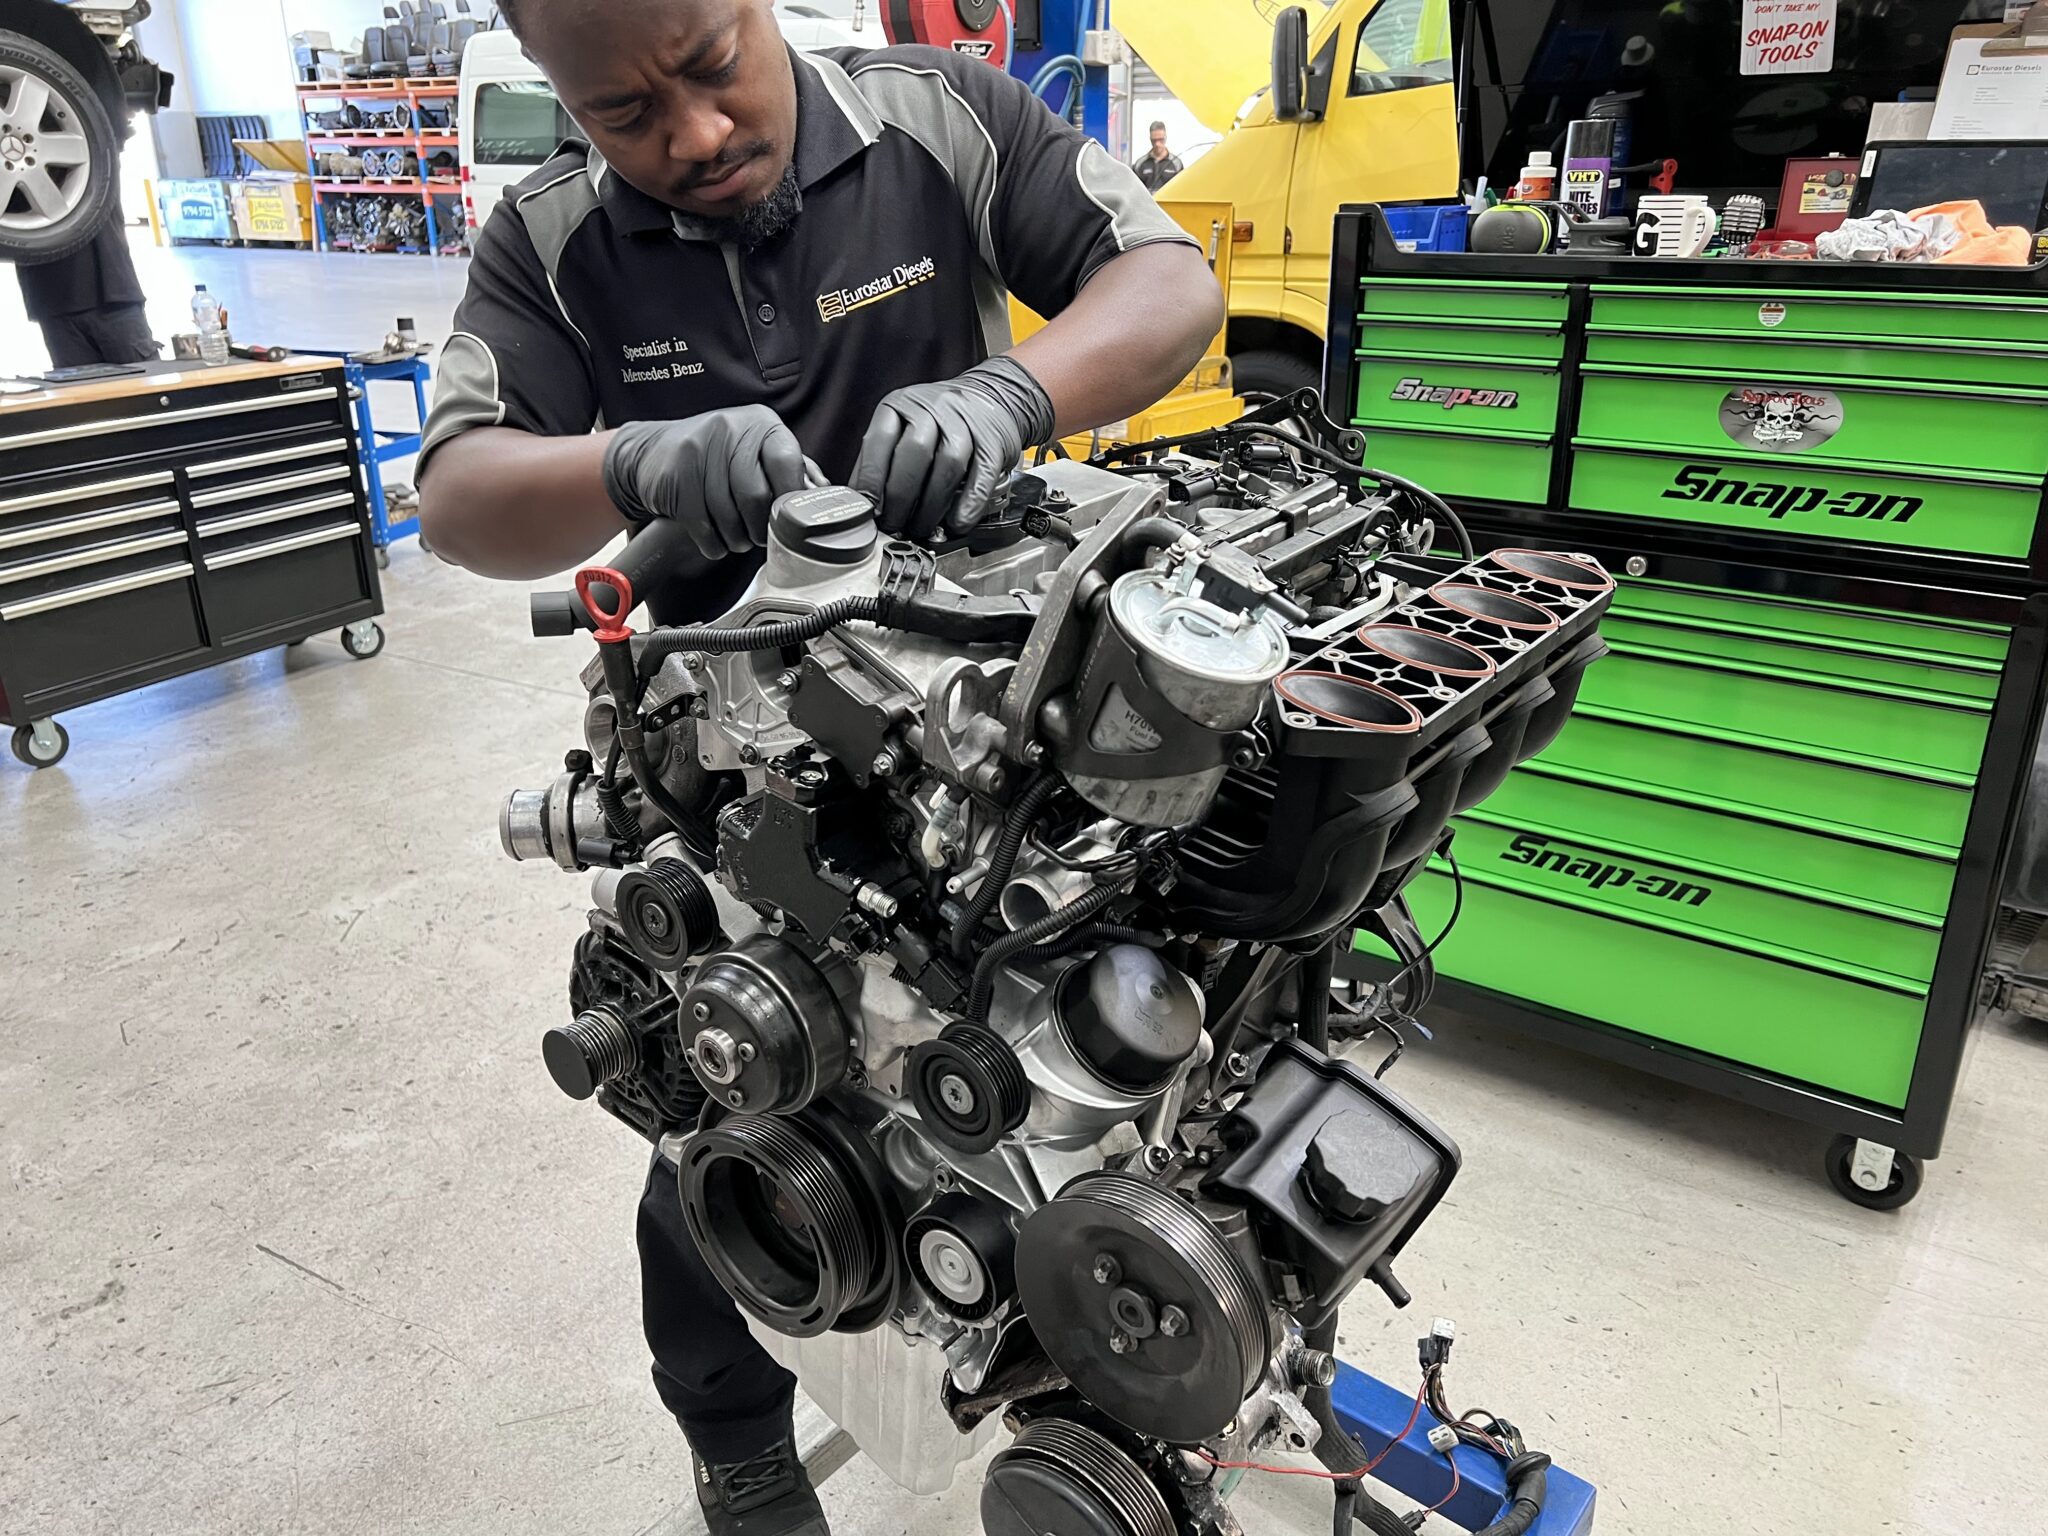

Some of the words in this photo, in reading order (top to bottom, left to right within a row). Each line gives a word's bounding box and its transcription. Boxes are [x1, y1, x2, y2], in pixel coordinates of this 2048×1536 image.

[1755, 5, 1781, 14] DON'T
[1784, 4, 1804, 12] TAKE
[1806, 3, 1820, 11] MY
[1745, 19, 1829, 47] SNAP-ON
[1759, 40, 1819, 65] TOOLS
[1569, 171, 1598, 182] VHT
[1569, 190, 1594, 203] NITE-
[841, 275, 893, 306] Eurostar
[893, 256, 934, 285] Diesels
[622, 339, 672, 362] Specialist
[673, 336, 689, 352] in
[621, 366, 670, 383] Mercedes
[670, 362, 704, 378] Benz
[1390, 378, 1517, 409] Snap-on
[1661, 465, 1923, 522] Snap-on
[1500, 834, 1711, 907] Snap-on
